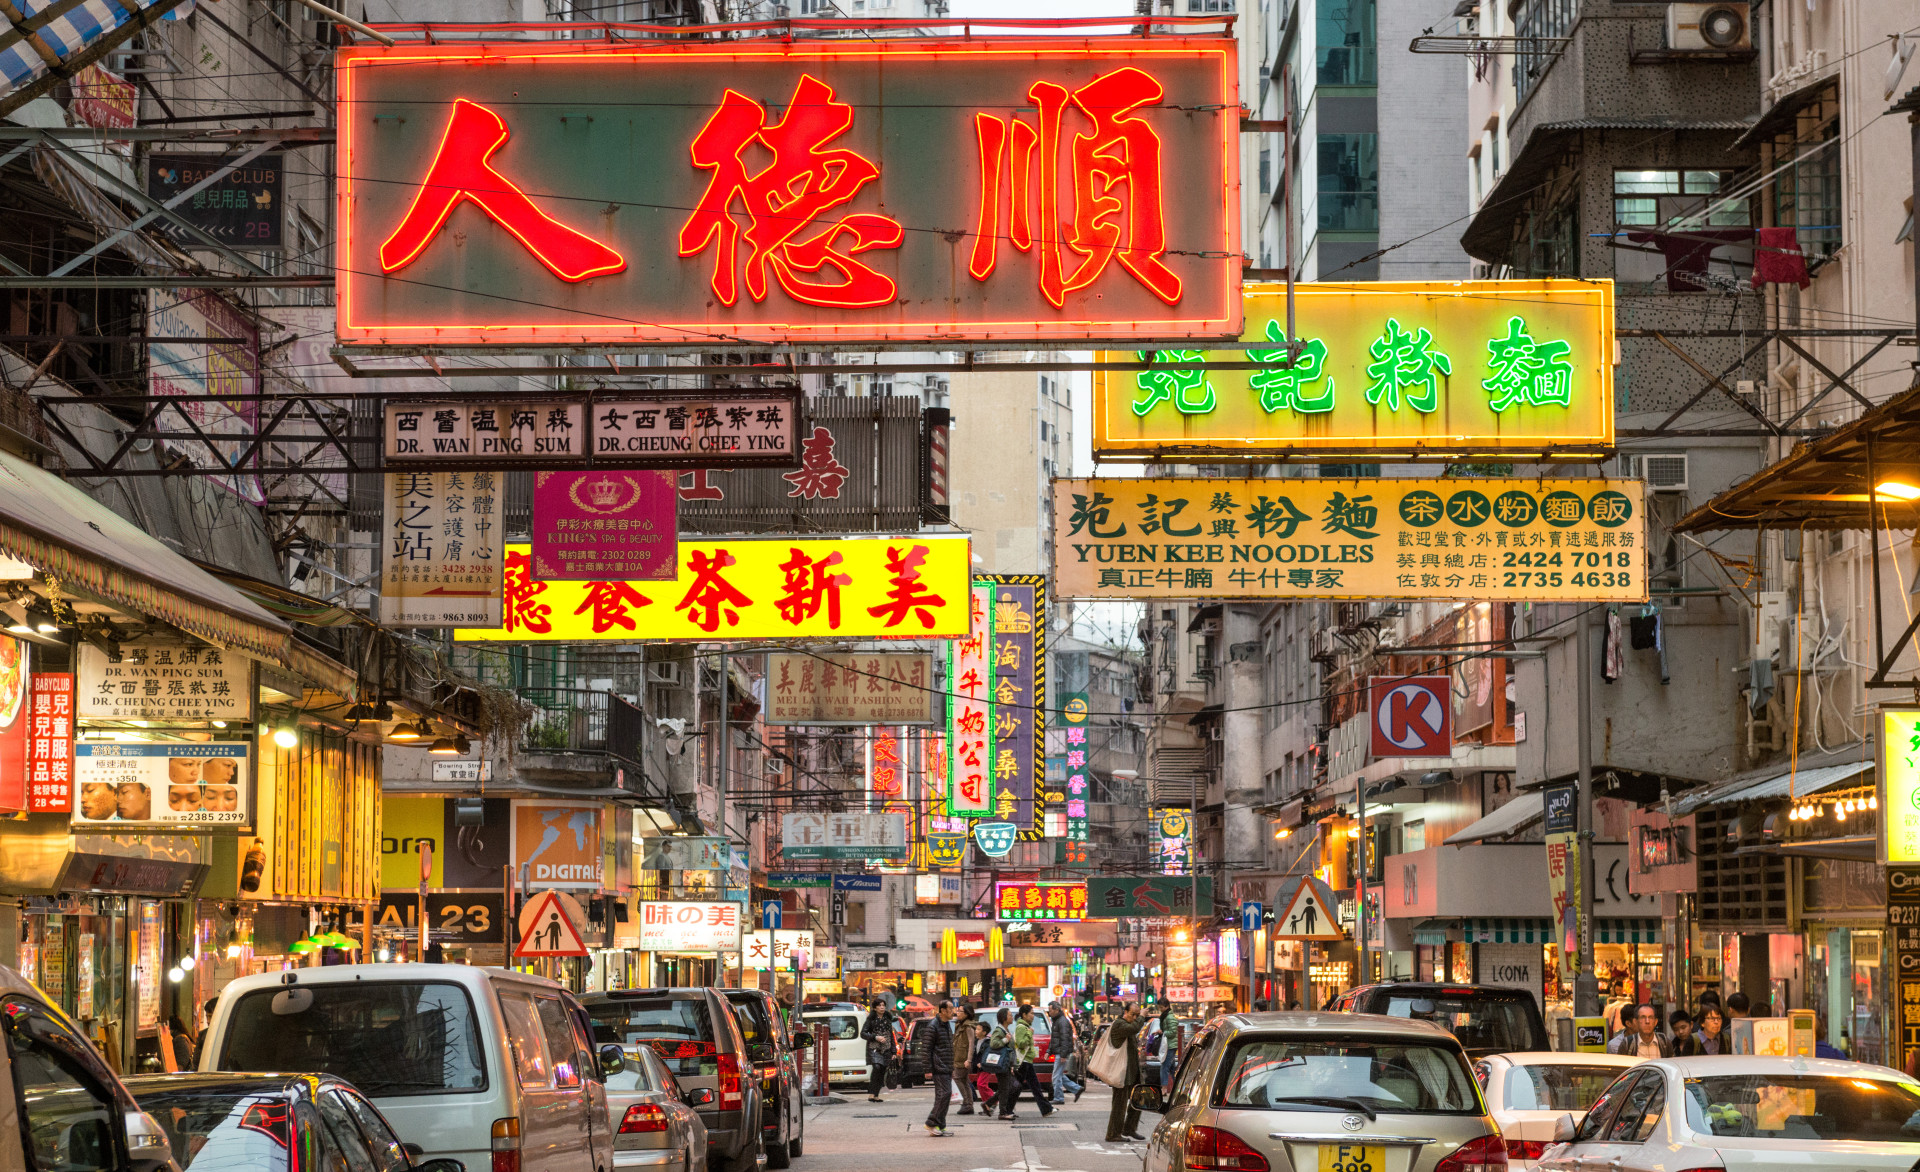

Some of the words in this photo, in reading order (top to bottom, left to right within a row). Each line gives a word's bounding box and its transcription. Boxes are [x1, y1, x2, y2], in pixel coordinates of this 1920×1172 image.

[231, 170, 275, 183] CLUB
[193, 189, 249, 209] 嬰兒用品
[245, 222, 271, 238] 2B
[396, 437, 424, 453] DR.
[433, 437, 470, 453] WAN
[483, 437, 523, 453] PING
[534, 437, 571, 452] SUM
[599, 436, 625, 452] DR.
[627, 436, 692, 451] CHEUNG
[699, 435, 741, 450] CHEE
[746, 435, 785, 450] YING
[442, 472, 466, 561] 美容護膚
[472, 472, 496, 560] 纖體中心
[1402, 494, 1629, 524] 茶水粉麵飯
[556, 519, 654, 531] 伊彩水療美容中心
[547, 532, 597, 543] KING'S
[601, 534, 616, 543] SPA
[620, 534, 626, 543] &
[629, 534, 663, 543] BEAUTY
[601, 550, 625, 560] 2302
[627, 550, 651, 560] 0289
[1071, 544, 1158, 563] YUEN
[1163, 544, 1225, 563] KEE
[1230, 544, 1375, 563] NOODLES
[1503, 551, 1563, 567] 2424
[1570, 551, 1631, 567] 7018
[441, 565, 466, 574] 3428
[469, 565, 493, 574] 2938
[1097, 567, 1213, 589] 真正牛腩
[1228, 567, 1344, 589] 牛什專家
[1503, 572, 1563, 588] 2735
[1570, 572, 1631, 588] 4638
[443, 613, 465, 622] 9863
[467, 613, 489, 622] 8093
[105, 668, 126, 677] DR.
[131, 668, 158, 677] WAN
[162, 668, 193, 678] PING
[197, 668, 223, 678] SUM
[92, 697, 112, 706] DR.
[115, 697, 166, 707] CHEUNG
[169, 698, 202, 707] CHEE
[205, 698, 235, 707] YING
[776, 696, 797, 705] MEI
[803, 696, 822, 705] LAI
[825, 696, 850, 705] WAH
[853, 696, 902, 704] FASHION
[909, 696, 924, 704] CO
[888, 708, 905, 717] 2736
[906, 708, 924, 717] 6876
[34, 798, 47, 807] 2B
[188, 813, 214, 821] 2385
[218, 813, 244, 821] 2399
[381, 830, 436, 854] bra
[536, 863, 595, 879] DIGITAL
[852, 880, 880, 888] Mizuno
[441, 905, 491, 933] 23
[645, 905, 736, 926] 味の美
[1492, 965, 1529, 982] LEONA
[1338, 1145, 1366, 1163] FJ
